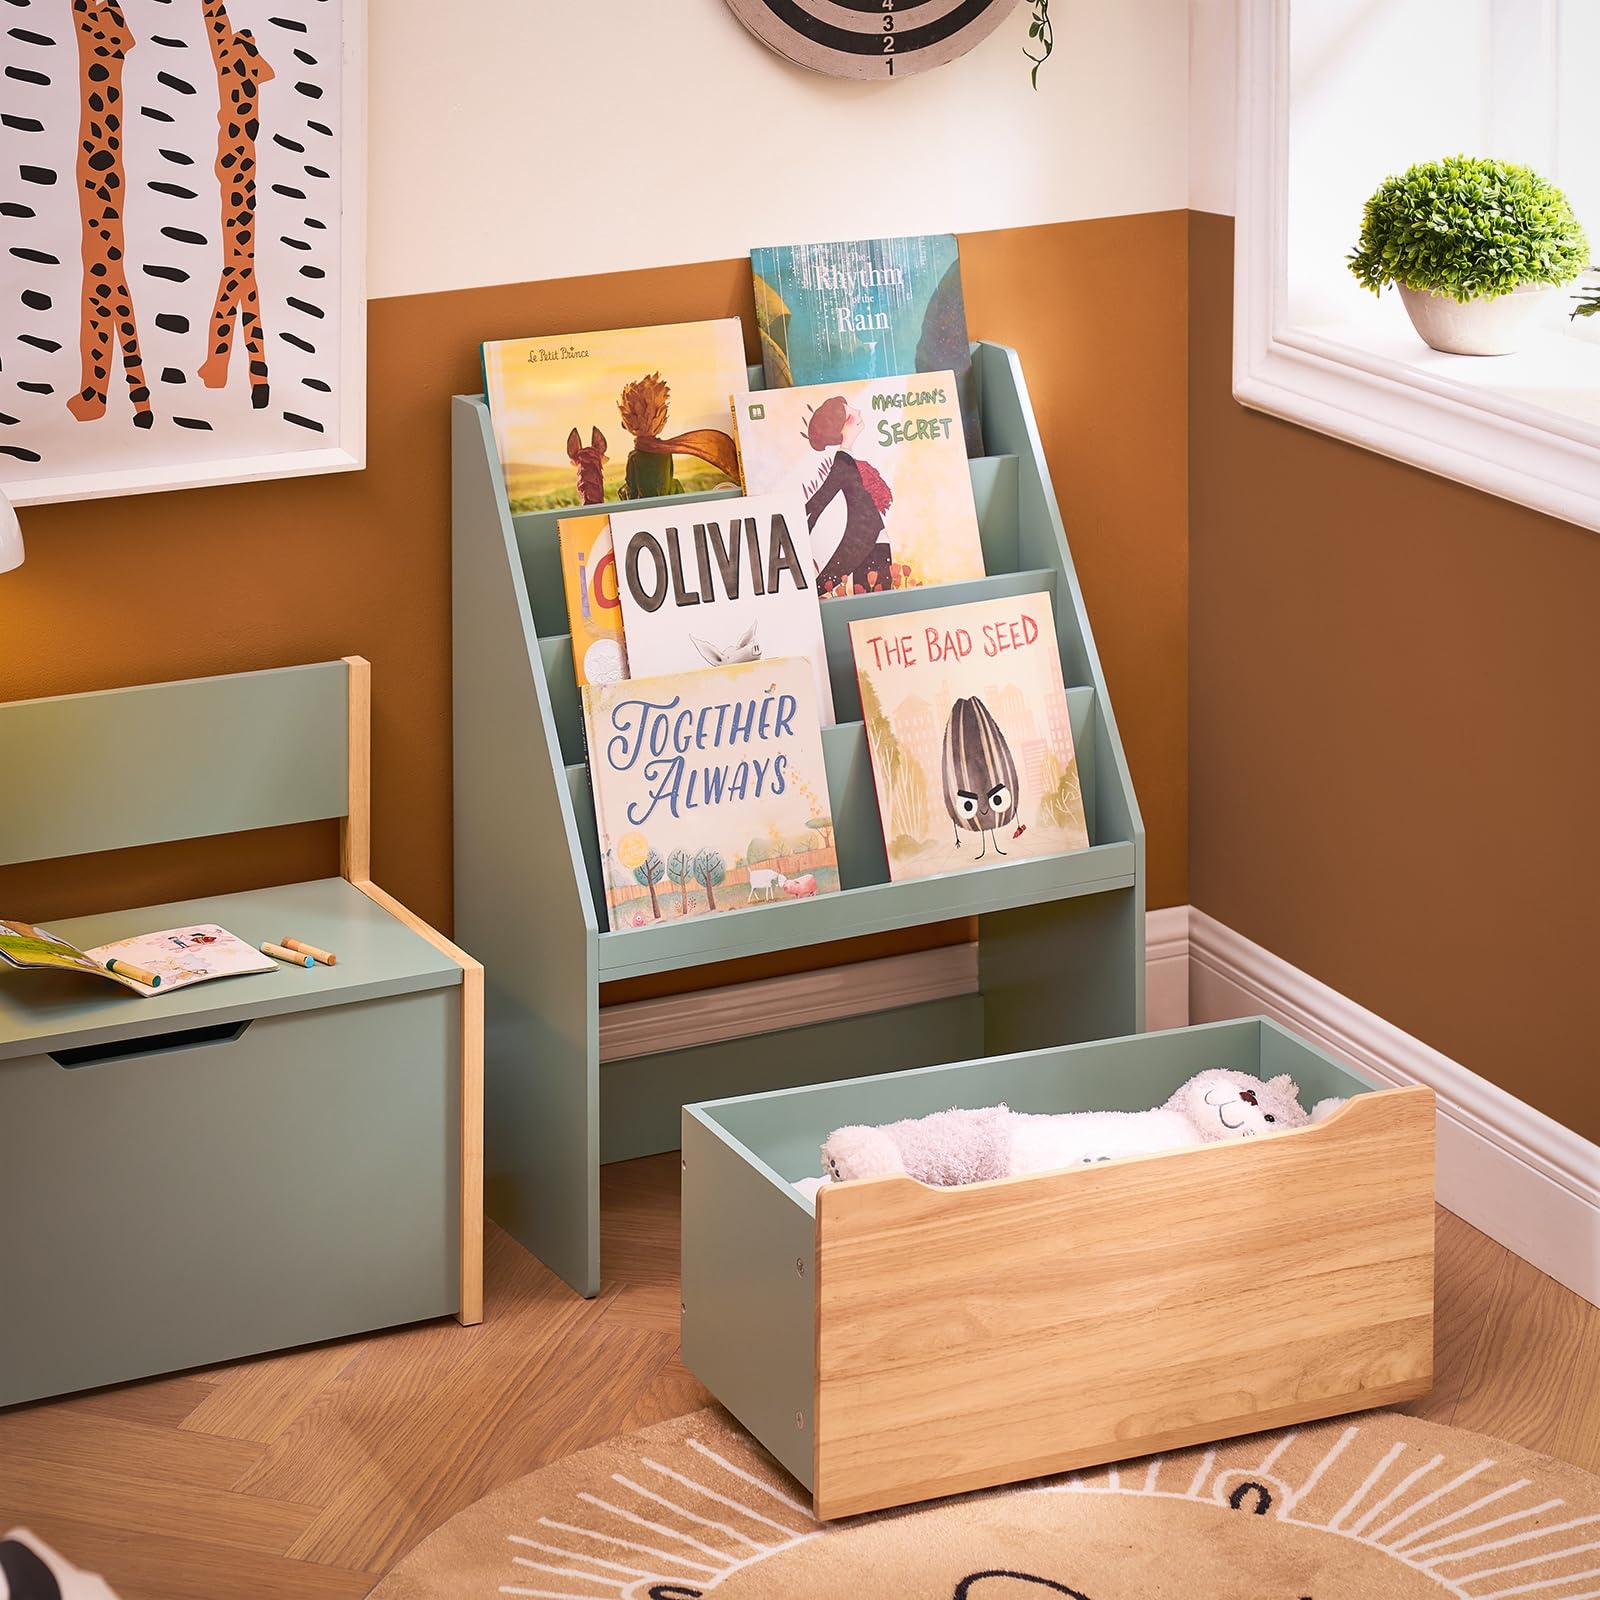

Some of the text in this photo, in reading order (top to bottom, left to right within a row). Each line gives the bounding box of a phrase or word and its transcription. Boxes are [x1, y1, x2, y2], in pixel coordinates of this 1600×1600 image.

[882, 0, 894, 11] 4
[883, 15, 894, 32] 3
[883, 36, 895, 53] 2
[885, 58, 894, 76] 1
[815, 262, 903, 296] Rhythm
[837, 306, 890, 332] Rain
[527, 346, 590, 364] Le Petit Prince
[871, 388, 947, 411] MAGICIAN'S
[877, 418, 952, 447] SECRET
[625, 513, 808, 613] OLIVIA
[866, 614, 1039, 671] THE BAD SEED
[607, 694, 797, 771] TOGETHER
[627, 754, 788, 826] ALWAYS
